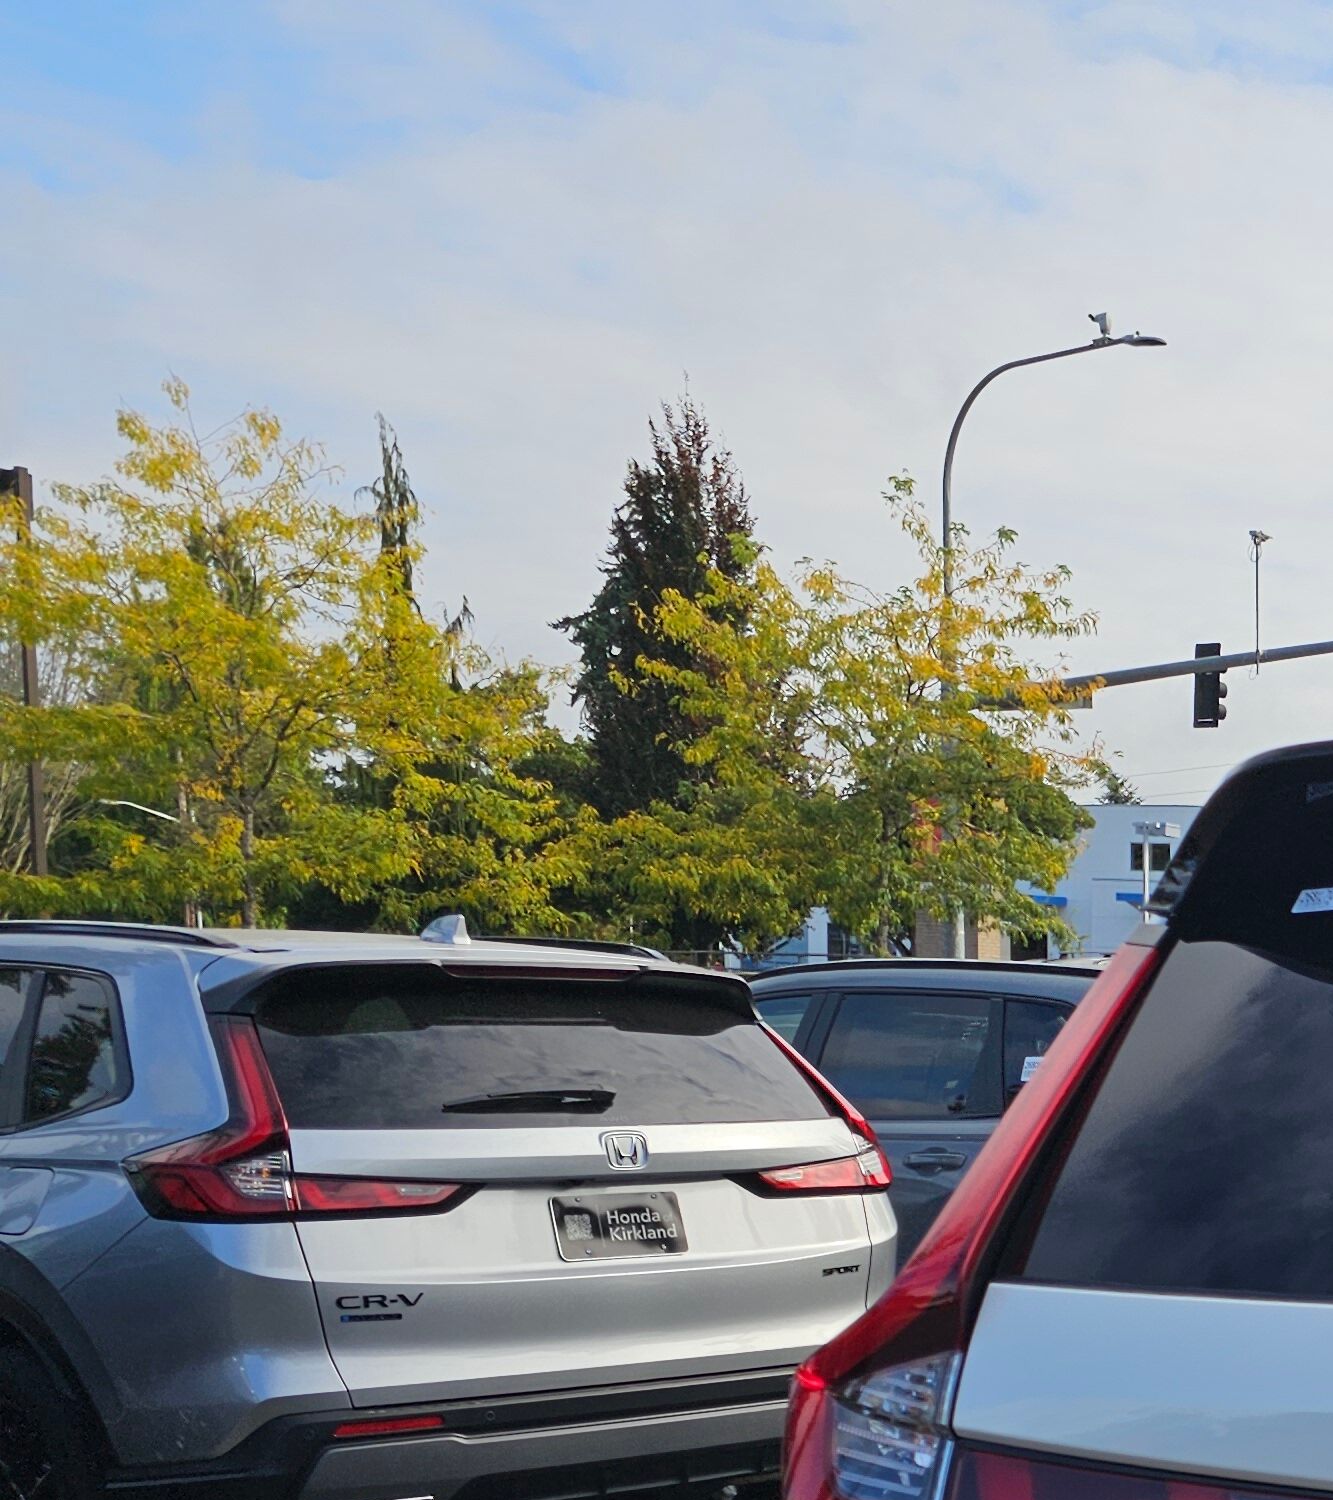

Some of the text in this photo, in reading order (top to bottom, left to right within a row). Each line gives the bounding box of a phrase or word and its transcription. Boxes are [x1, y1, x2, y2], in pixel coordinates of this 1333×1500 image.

[607, 1207, 660, 1225] Honda
[610, 1223, 678, 1241] Kirkland
[335, 1292, 424, 1310] CR-V
